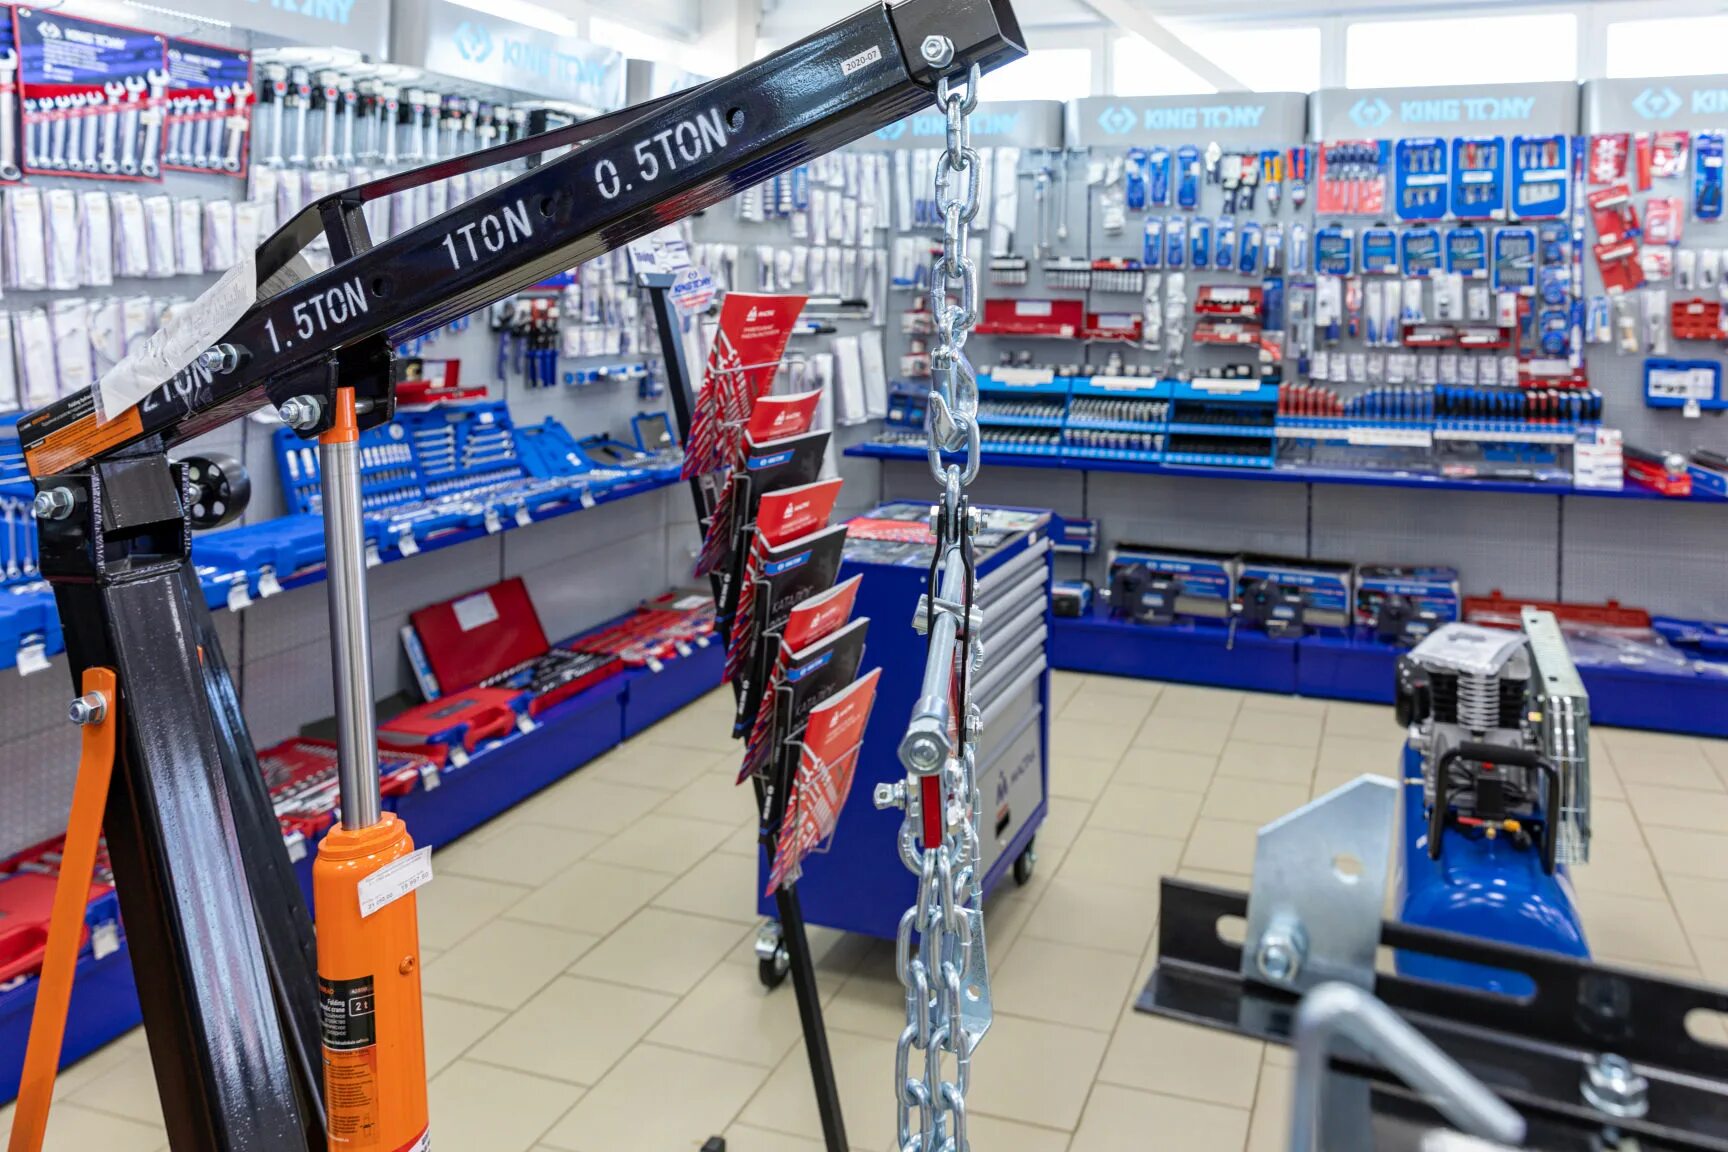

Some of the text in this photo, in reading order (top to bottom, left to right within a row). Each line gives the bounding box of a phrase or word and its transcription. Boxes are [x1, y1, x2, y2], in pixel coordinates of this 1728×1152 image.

[845, 50, 878, 72] 2020-07
[1143, 105, 1266, 130] KING TONY
[1400, 95, 1537, 124] KING TONY
[593, 107, 731, 202] 0.5TON
[441, 198, 536, 272] 1TON
[263, 276, 370, 354] 1.5TON
[355, 1000, 369, 1012] 2 t
